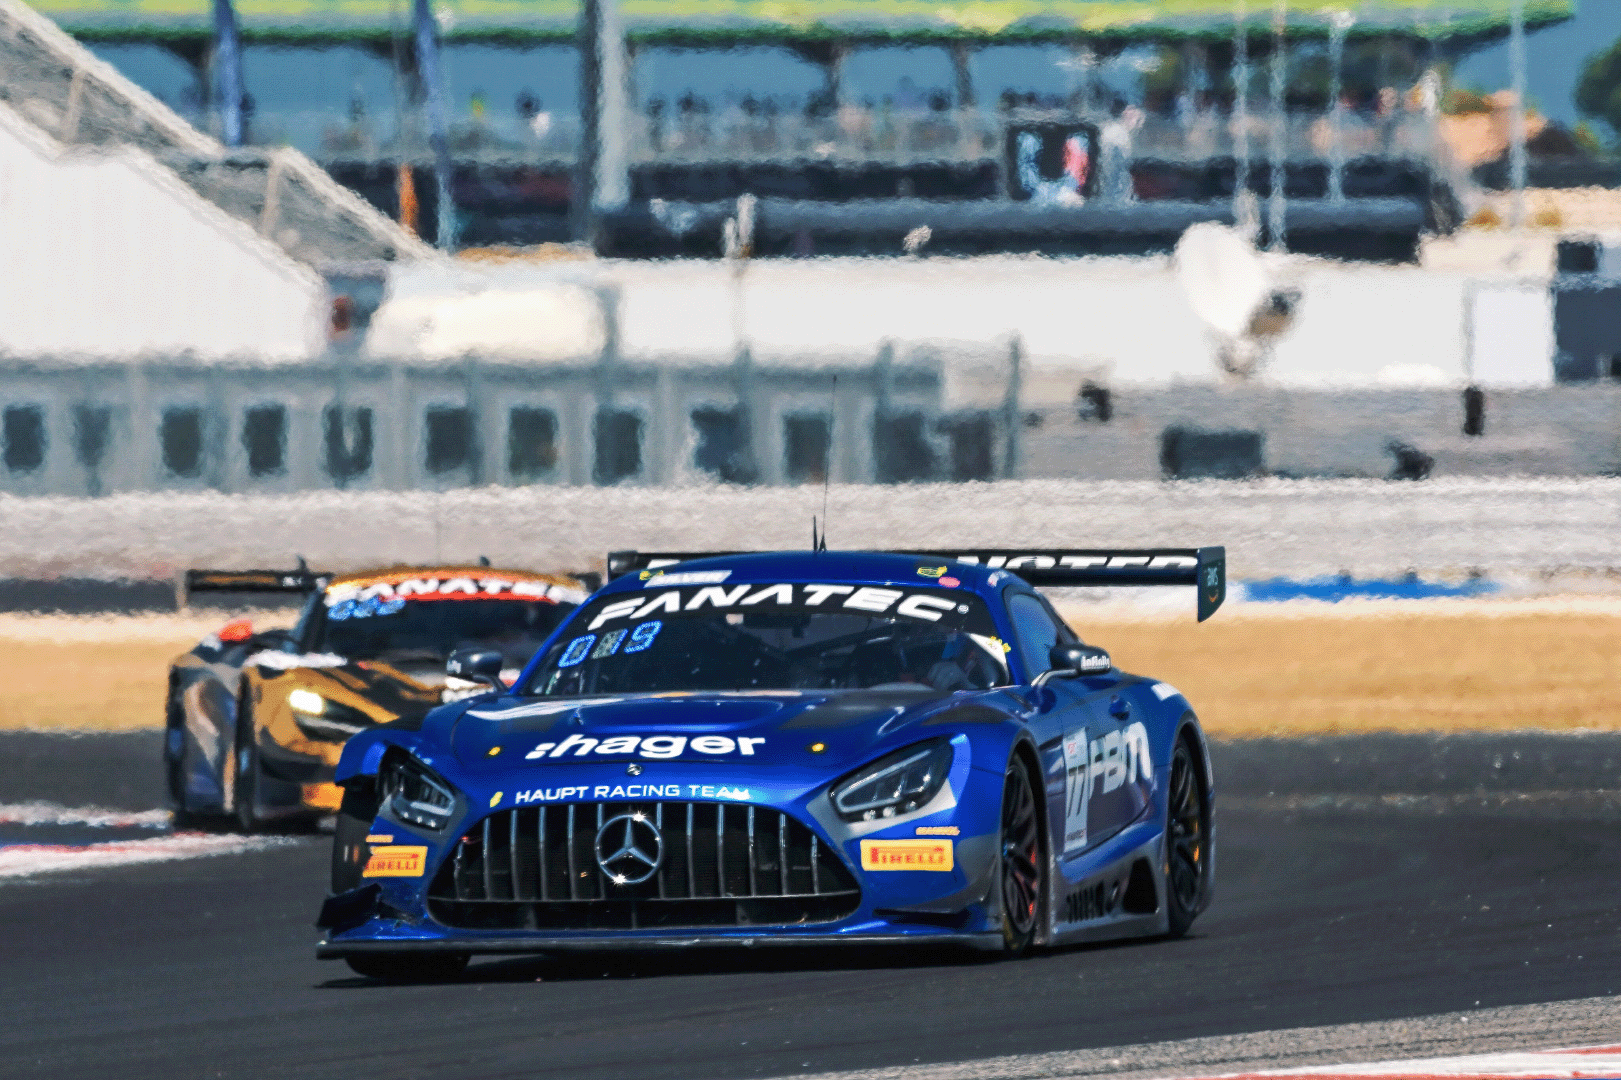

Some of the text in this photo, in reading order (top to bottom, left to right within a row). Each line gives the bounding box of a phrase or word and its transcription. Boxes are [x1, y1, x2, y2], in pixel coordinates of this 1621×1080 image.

[588, 584, 958, 630] FANATEC
[515, 784, 751, 804] HAUPT RACING TEAM
